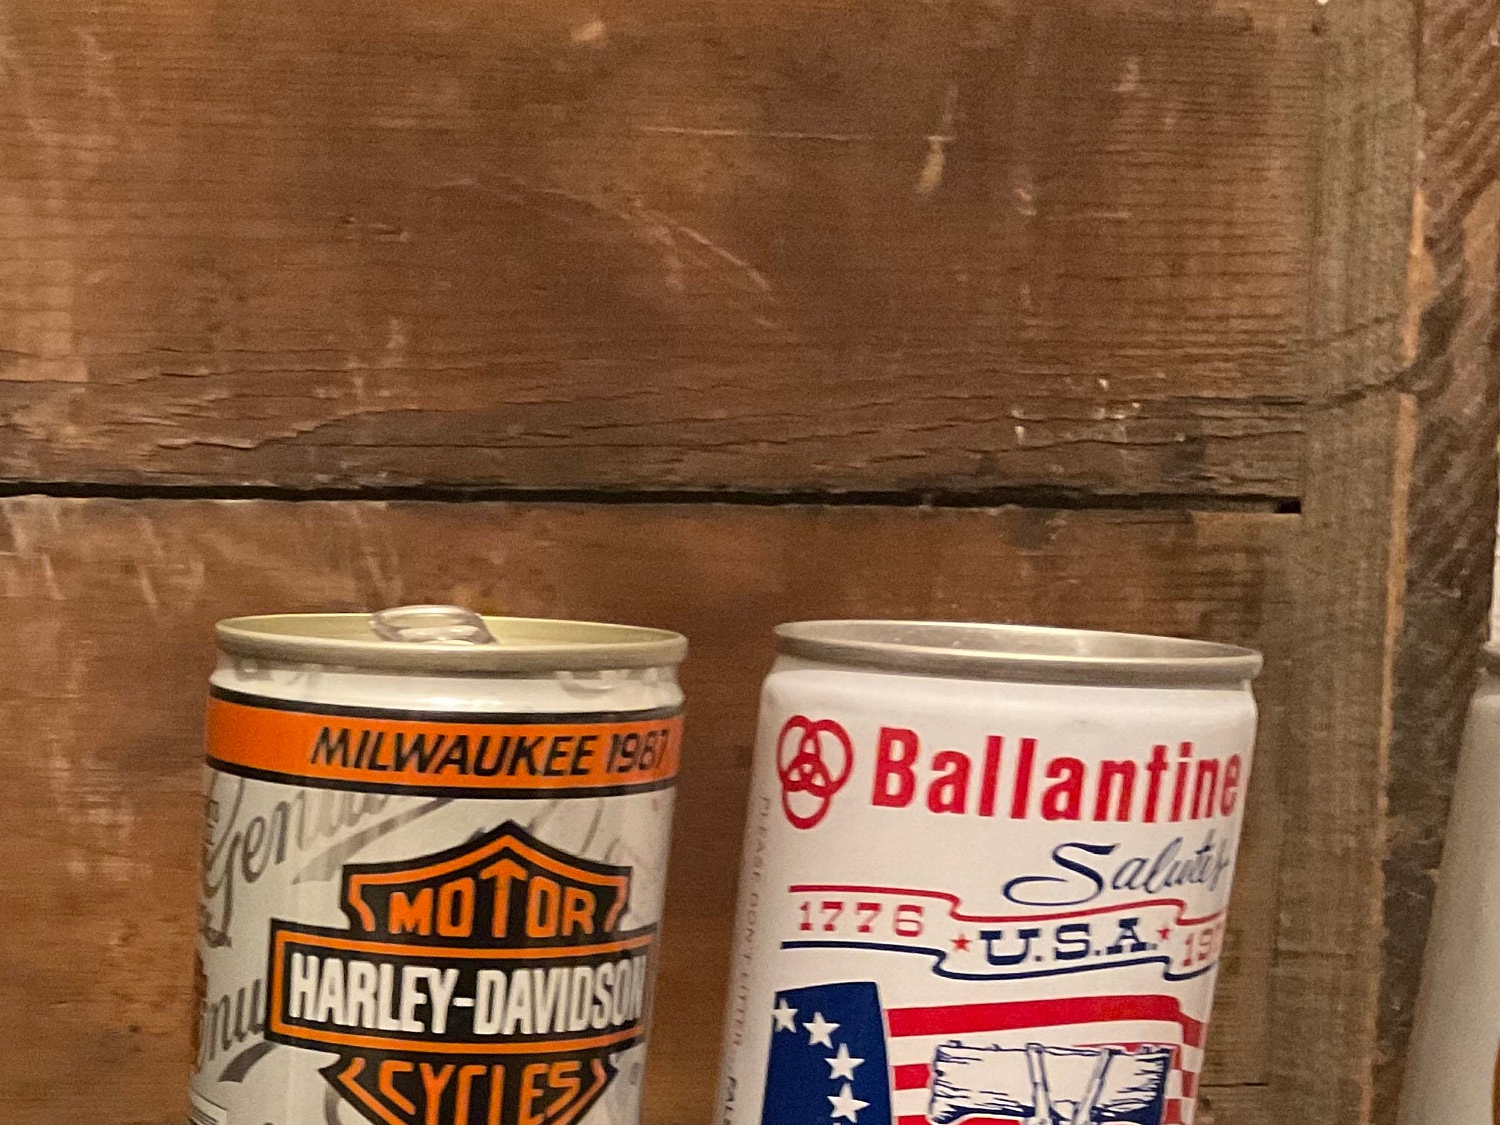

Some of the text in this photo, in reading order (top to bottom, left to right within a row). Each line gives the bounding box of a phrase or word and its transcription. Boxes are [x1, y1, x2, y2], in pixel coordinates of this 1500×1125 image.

[309, 726, 673, 778] MILWAUKEE 1987
[871, 726, 1242, 824] Ballantine
[388, 857, 596, 939] MOTOR
[797, 901, 925, 938] 1776
[979, 916, 1158, 966] U.S.A.
[289, 952, 646, 1036] HARLEY-DAVIDSON
